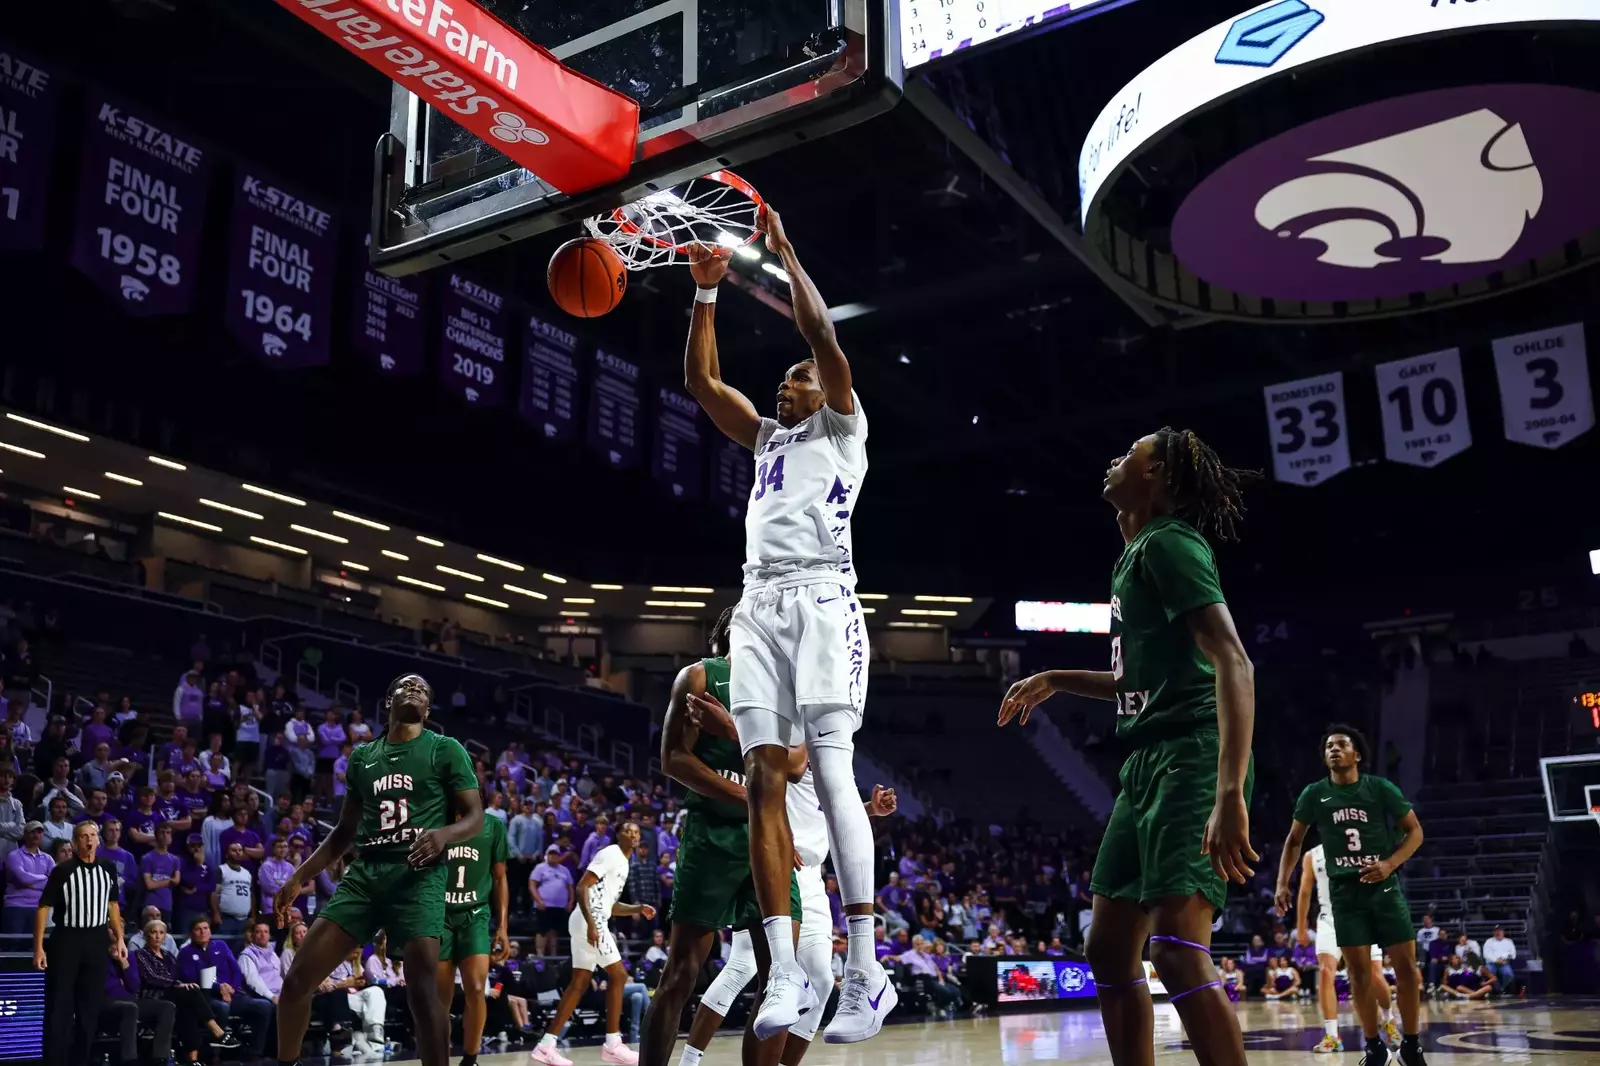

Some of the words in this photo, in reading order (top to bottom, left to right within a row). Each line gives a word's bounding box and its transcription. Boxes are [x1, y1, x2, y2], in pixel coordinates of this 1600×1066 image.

[910, 23, 923, 36] 11
[945, 13, 952, 24] 3
[976, 1, 984, 12] 0
[911, 8, 918, 19] 3
[911, 39, 926, 54] 34
[946, 29, 954, 40] 8
[978, 17, 987, 29] 0
[98, 102, 203, 168] K-STATE
[108, 156, 182, 213] FINAL
[104, 180, 178, 236] FOUR
[241, 174, 331, 231] K-STATE
[96, 227, 181, 287] 1958
[250, 224, 315, 274] FINAL
[248, 246, 311, 293] FOUR
[450, 273, 504, 309] K-STATE
[241, 289, 312, 342] 1964
[1513, 336, 1565, 355] OHLDE
[452, 352, 495, 385] 2019
[1399, 363, 1437, 379] GARY
[1525, 357, 1564, 410] 3
[1271, 382, 1336, 404] ROMSTAD
[1386, 377, 1458, 433] 10
[1274, 400, 1340, 454] 33
[755, 454, 785, 502] 34
[1255, 619, 1289, 644] 24
[373, 773, 414, 797] MISS
[379, 797, 409, 832] 21
[1332, 807, 1368, 824] MISS
[447, 846, 479, 862] MISS
[1344, 827, 1362, 851] 3
[235, 885, 249, 897] 25
[456, 864, 466, 889] 1
